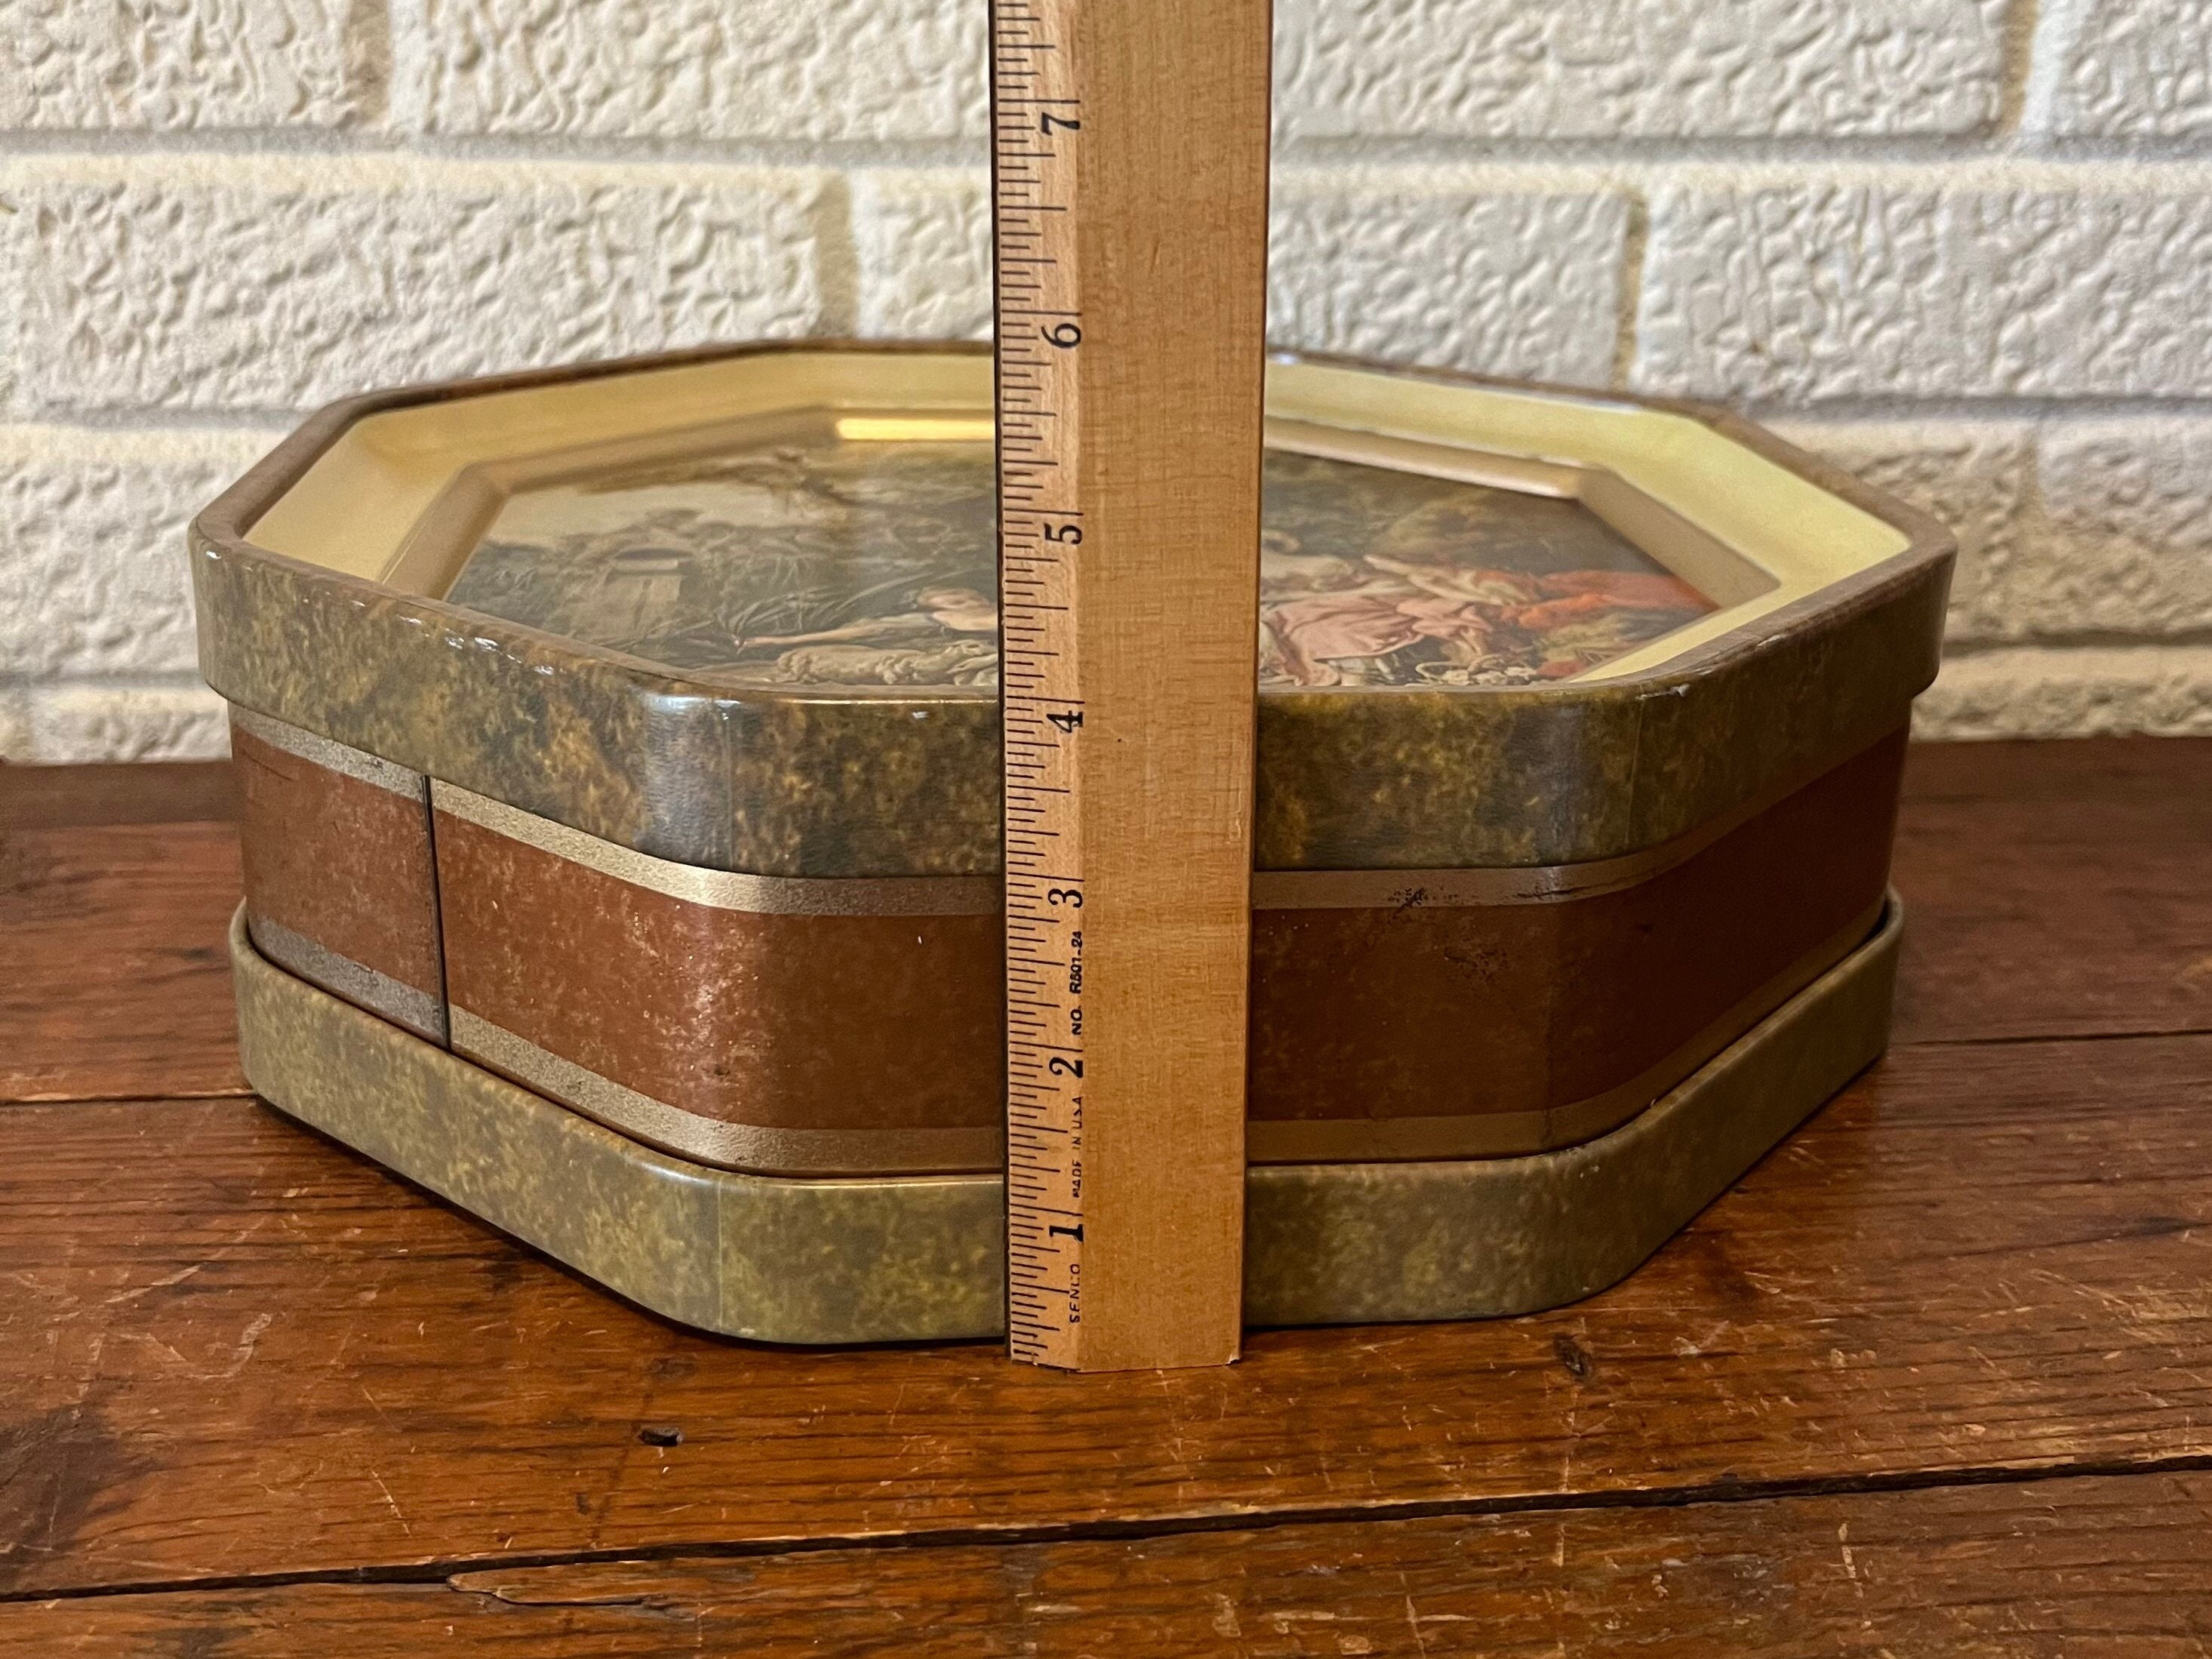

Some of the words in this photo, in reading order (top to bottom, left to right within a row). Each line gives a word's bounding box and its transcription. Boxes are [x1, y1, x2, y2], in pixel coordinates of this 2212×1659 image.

[1041, 112, 1081, 136] 7
[1041, 322, 1081, 349] 6
[1044, 522, 1083, 545] 5
[1045, 710, 1084, 734] 4
[1048, 888, 1083, 909] 3
[1048, 1057, 1084, 1079] 2
[1072, 1136, 1081, 1150] IN
[1049, 1223, 1084, 1242] 1
